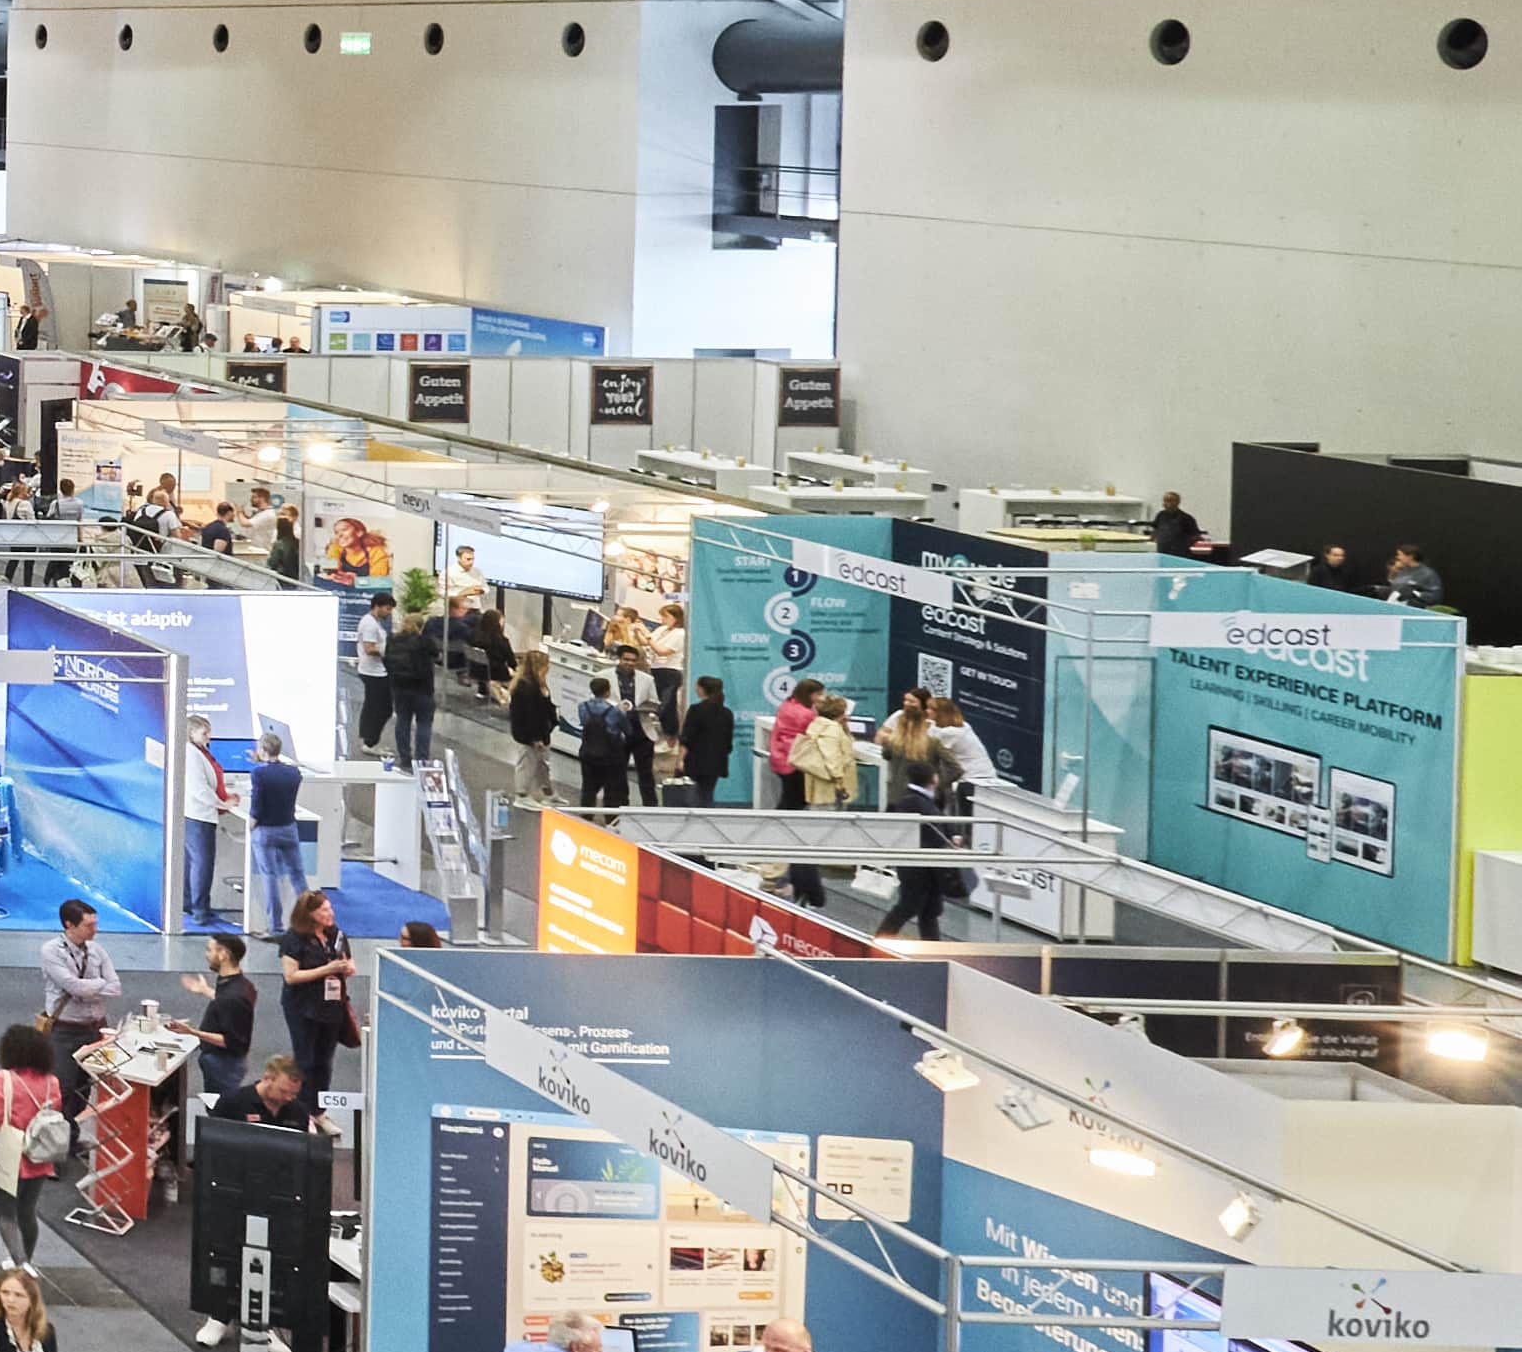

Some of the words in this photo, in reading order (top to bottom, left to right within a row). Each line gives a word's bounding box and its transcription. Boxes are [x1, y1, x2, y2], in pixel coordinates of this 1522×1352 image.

[419, 374, 462, 389] Guten
[789, 379, 832, 393] Guten
[415, 392, 465, 408] Appetit
[784, 396, 835, 411] Appetit
[791, 571, 799, 583] 1
[839, 561, 908, 595] edcast
[130, 611, 192, 631] adaptiv
[782, 607, 790, 619] 2
[1226, 623, 1331, 647] edcast
[790, 645, 799, 657] 3
[1170, 647, 1231, 677] TALENT
[1235, 663, 1339, 704] EXPERIENCE
[1344, 691, 1443, 731] PLATFORM
[1190, 677, 1245, 702] LEARNING
[1252, 692, 1303, 718] SKILLING
[1311, 708, 1356, 733] CAREER
[1359, 720, 1416, 745] MOBILITY
[580, 845, 627, 874] mecom
[579, 1025, 634, 1038] Prozess-
[590, 1041, 670, 1056] Gamification
[539, 1066, 591, 1115] koviko
[323, 1095, 348, 1107] C50
[648, 1128, 707, 1183] koviko
[986, 1218, 1017, 1253] Mit
[1327, 1310, 1430, 1341] koviko
